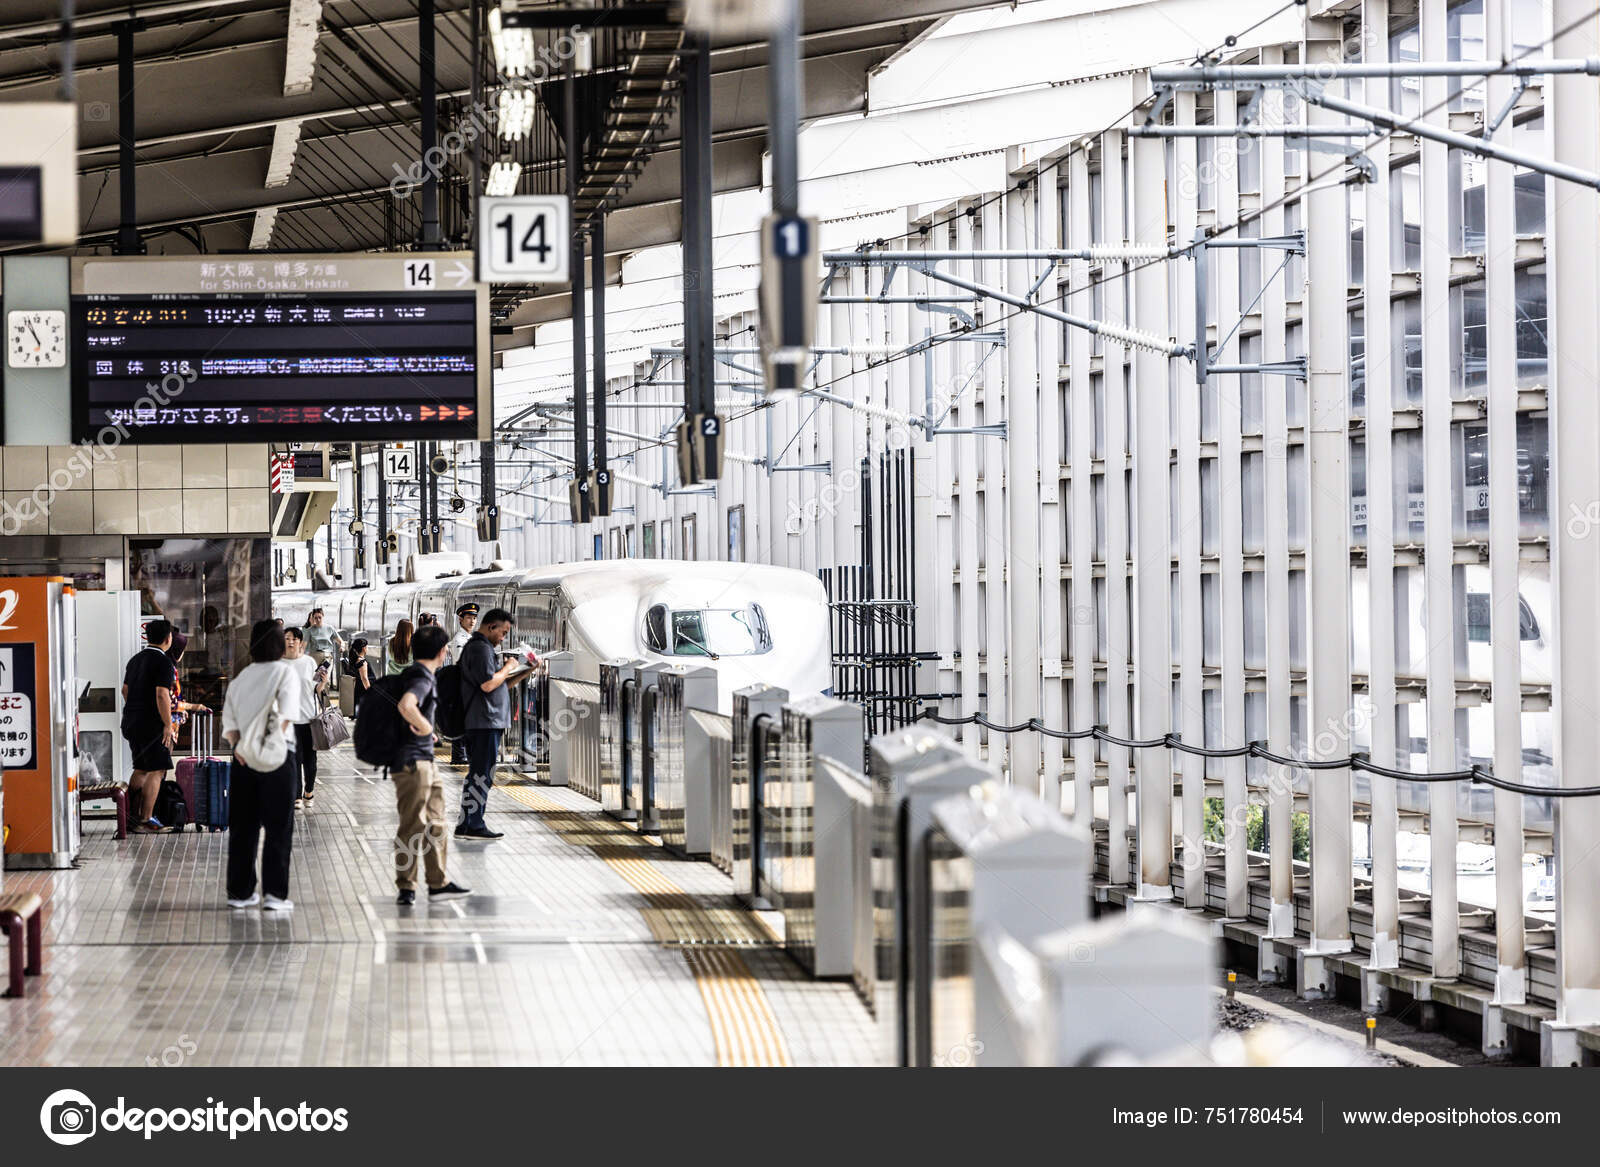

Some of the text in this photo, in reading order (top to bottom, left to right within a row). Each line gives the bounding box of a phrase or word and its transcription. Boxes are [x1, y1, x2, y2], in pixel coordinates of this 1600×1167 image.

[496, 213, 552, 264] 14
[781, 224, 798, 255] 1
[407, 263, 432, 286] 14
[200, 279, 218, 290] for
[304, 279, 349, 289] Hakata
[704, 418, 717, 434] 2
[388, 454, 410, 474] 14
[599, 472, 608, 484] 3
[580, 482, 588, 492] 4
[489, 507, 496, 516] 4
[433, 525, 439, 533] 5
